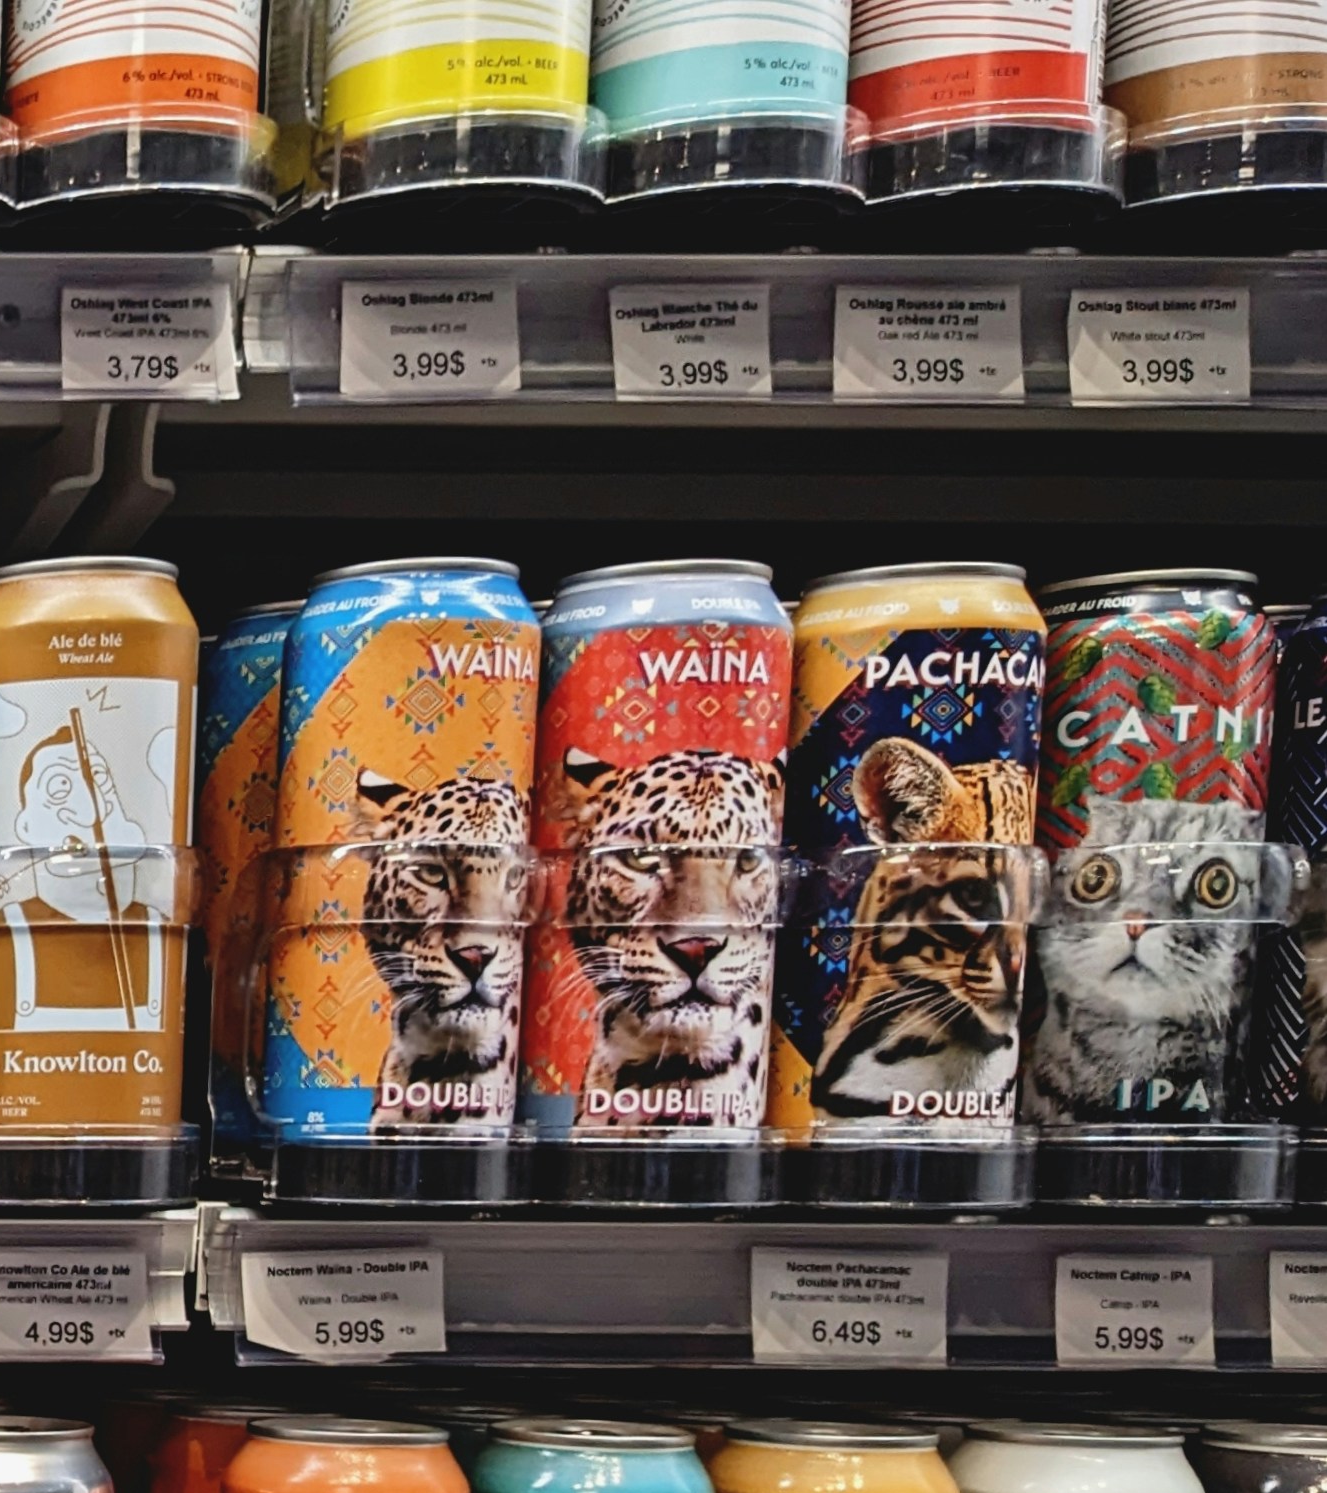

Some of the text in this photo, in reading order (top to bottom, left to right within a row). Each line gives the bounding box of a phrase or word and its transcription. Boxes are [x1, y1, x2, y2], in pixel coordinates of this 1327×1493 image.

[107, 354, 179, 381] 3,79$
[392, 351, 466, 380] 3,99$
[893, 356, 965, 386] 3,99$
[1122, 357, 1194, 387] 3,99$
[48, 632, 122, 650] Ale blé
[58, 652, 90, 664] Wheat
[427, 639, 535, 681] WAÏNA
[639, 645, 769, 685] WAÏNA
[1057, 705, 1274, 747] CATNI
[4, 1049, 163, 1074] Knowlton Co.
[588, 1089, 714, 1115] DOUBLE
[1115, 1078, 1212, 1111] IPA
[25, 1322, 95, 1346] 4,99$
[315, 1319, 385, 1347] 5,99$
[812, 1319, 882, 1347] 6,49$
